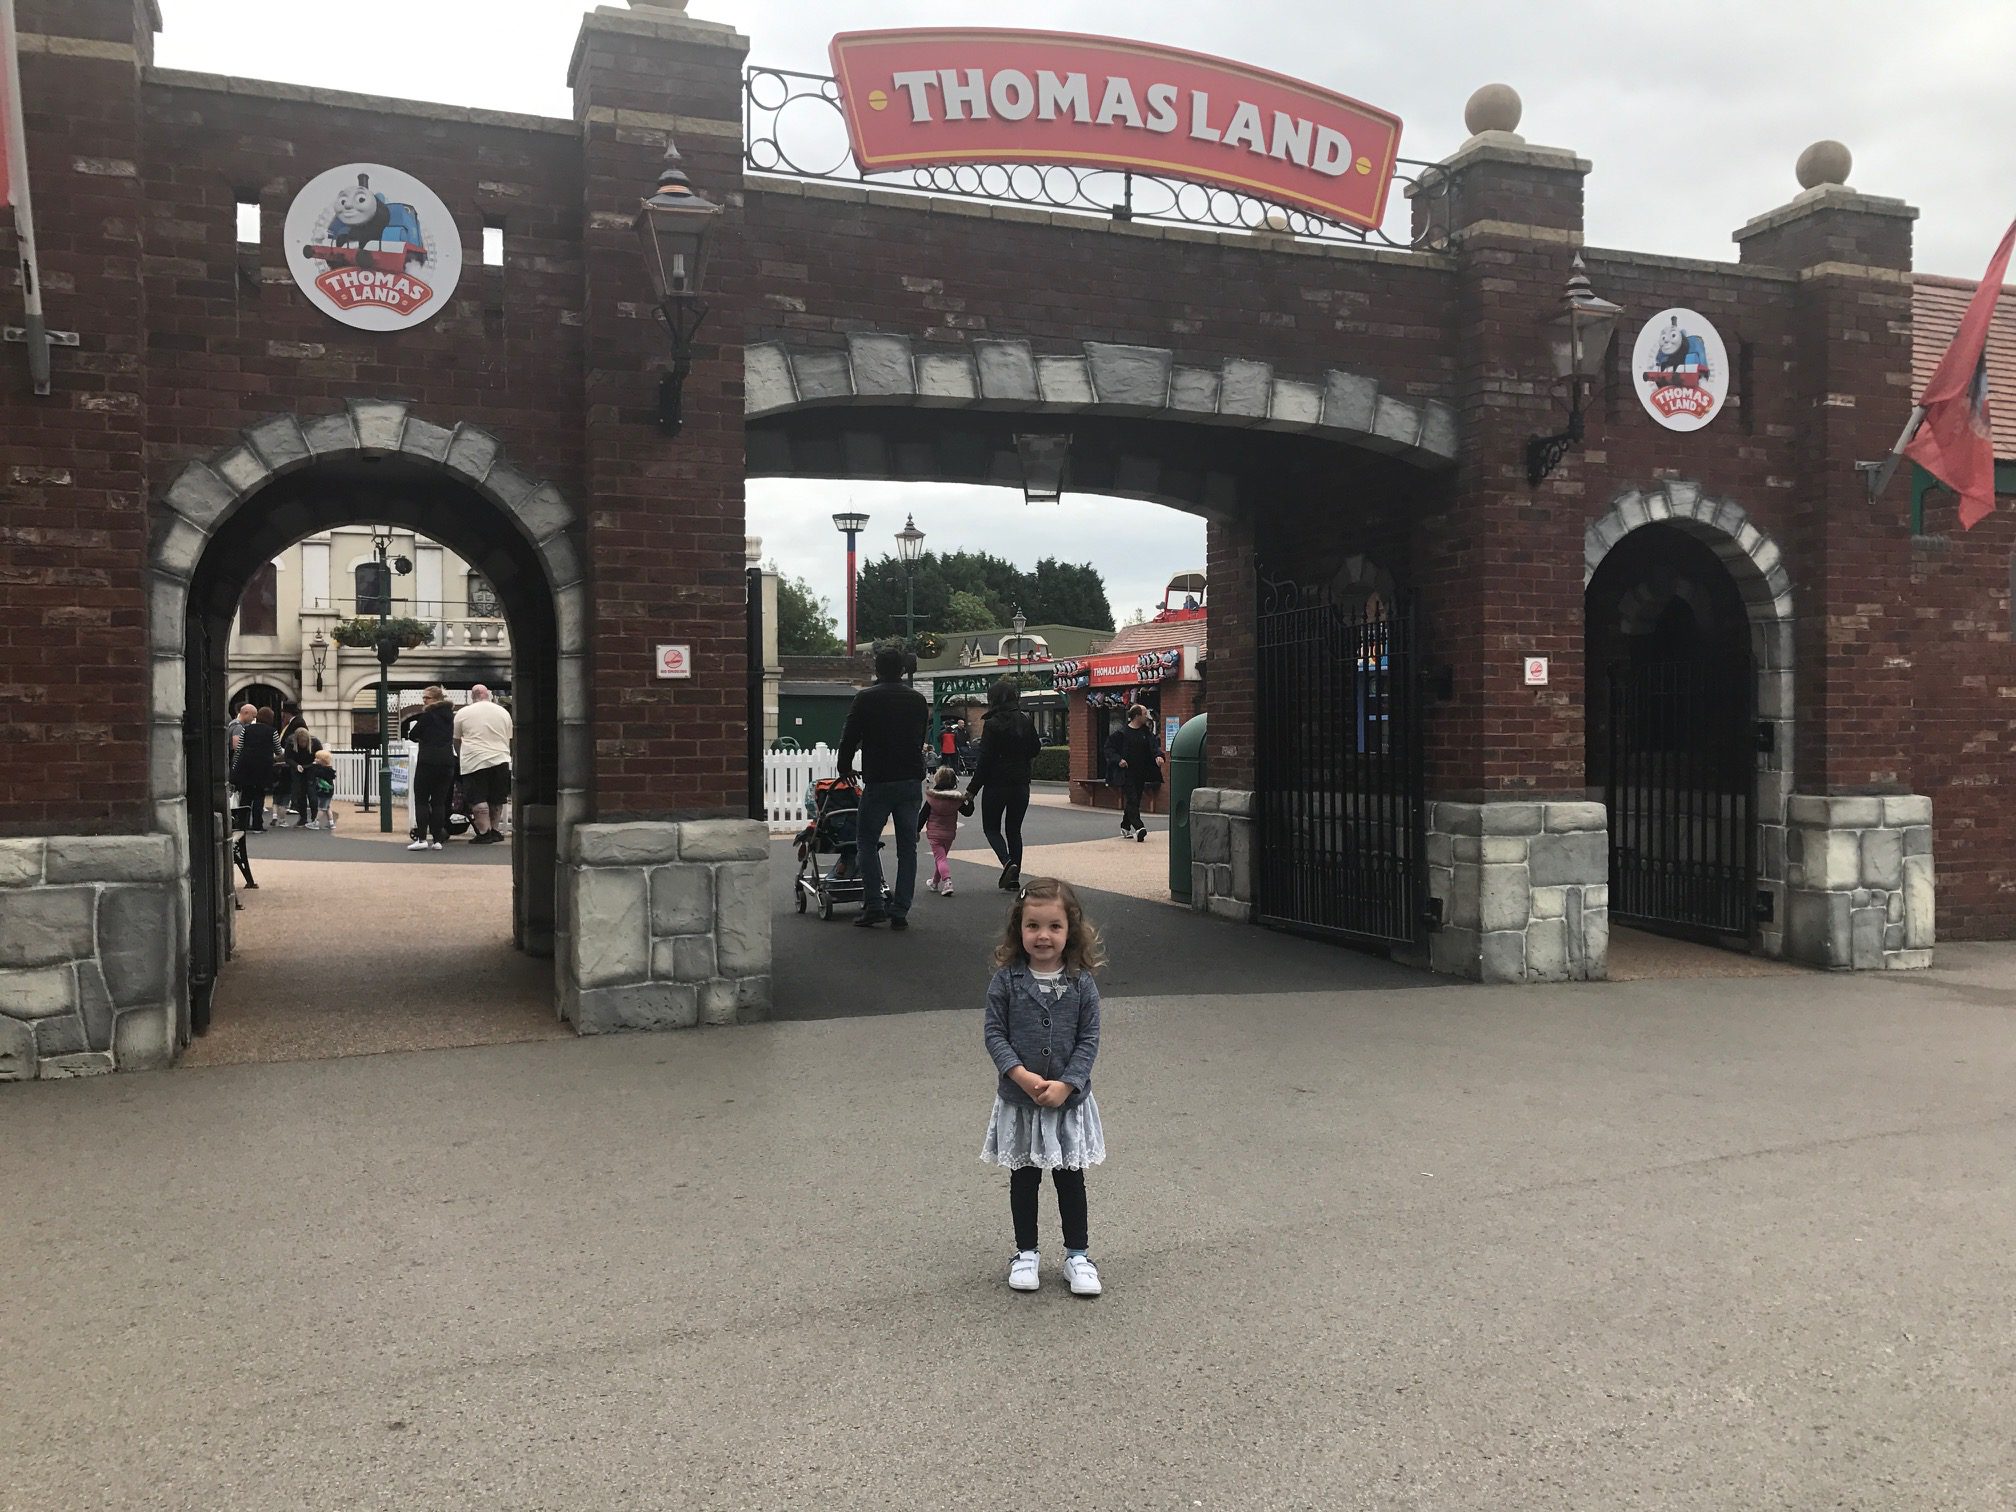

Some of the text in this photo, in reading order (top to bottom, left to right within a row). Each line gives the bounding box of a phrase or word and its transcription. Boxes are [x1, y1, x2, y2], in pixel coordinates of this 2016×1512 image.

[893, 68, 1353, 177] THOMAS LAND
[325, 271, 425, 300] THOMAS
[350, 287, 400, 304] LAND
[1656, 388, 1710, 406] THOMAS
[1670, 399, 1697, 411] LAND
[1094, 667, 1115, 676] THOMAS
[1115, 665, 1130, 675] LAND
